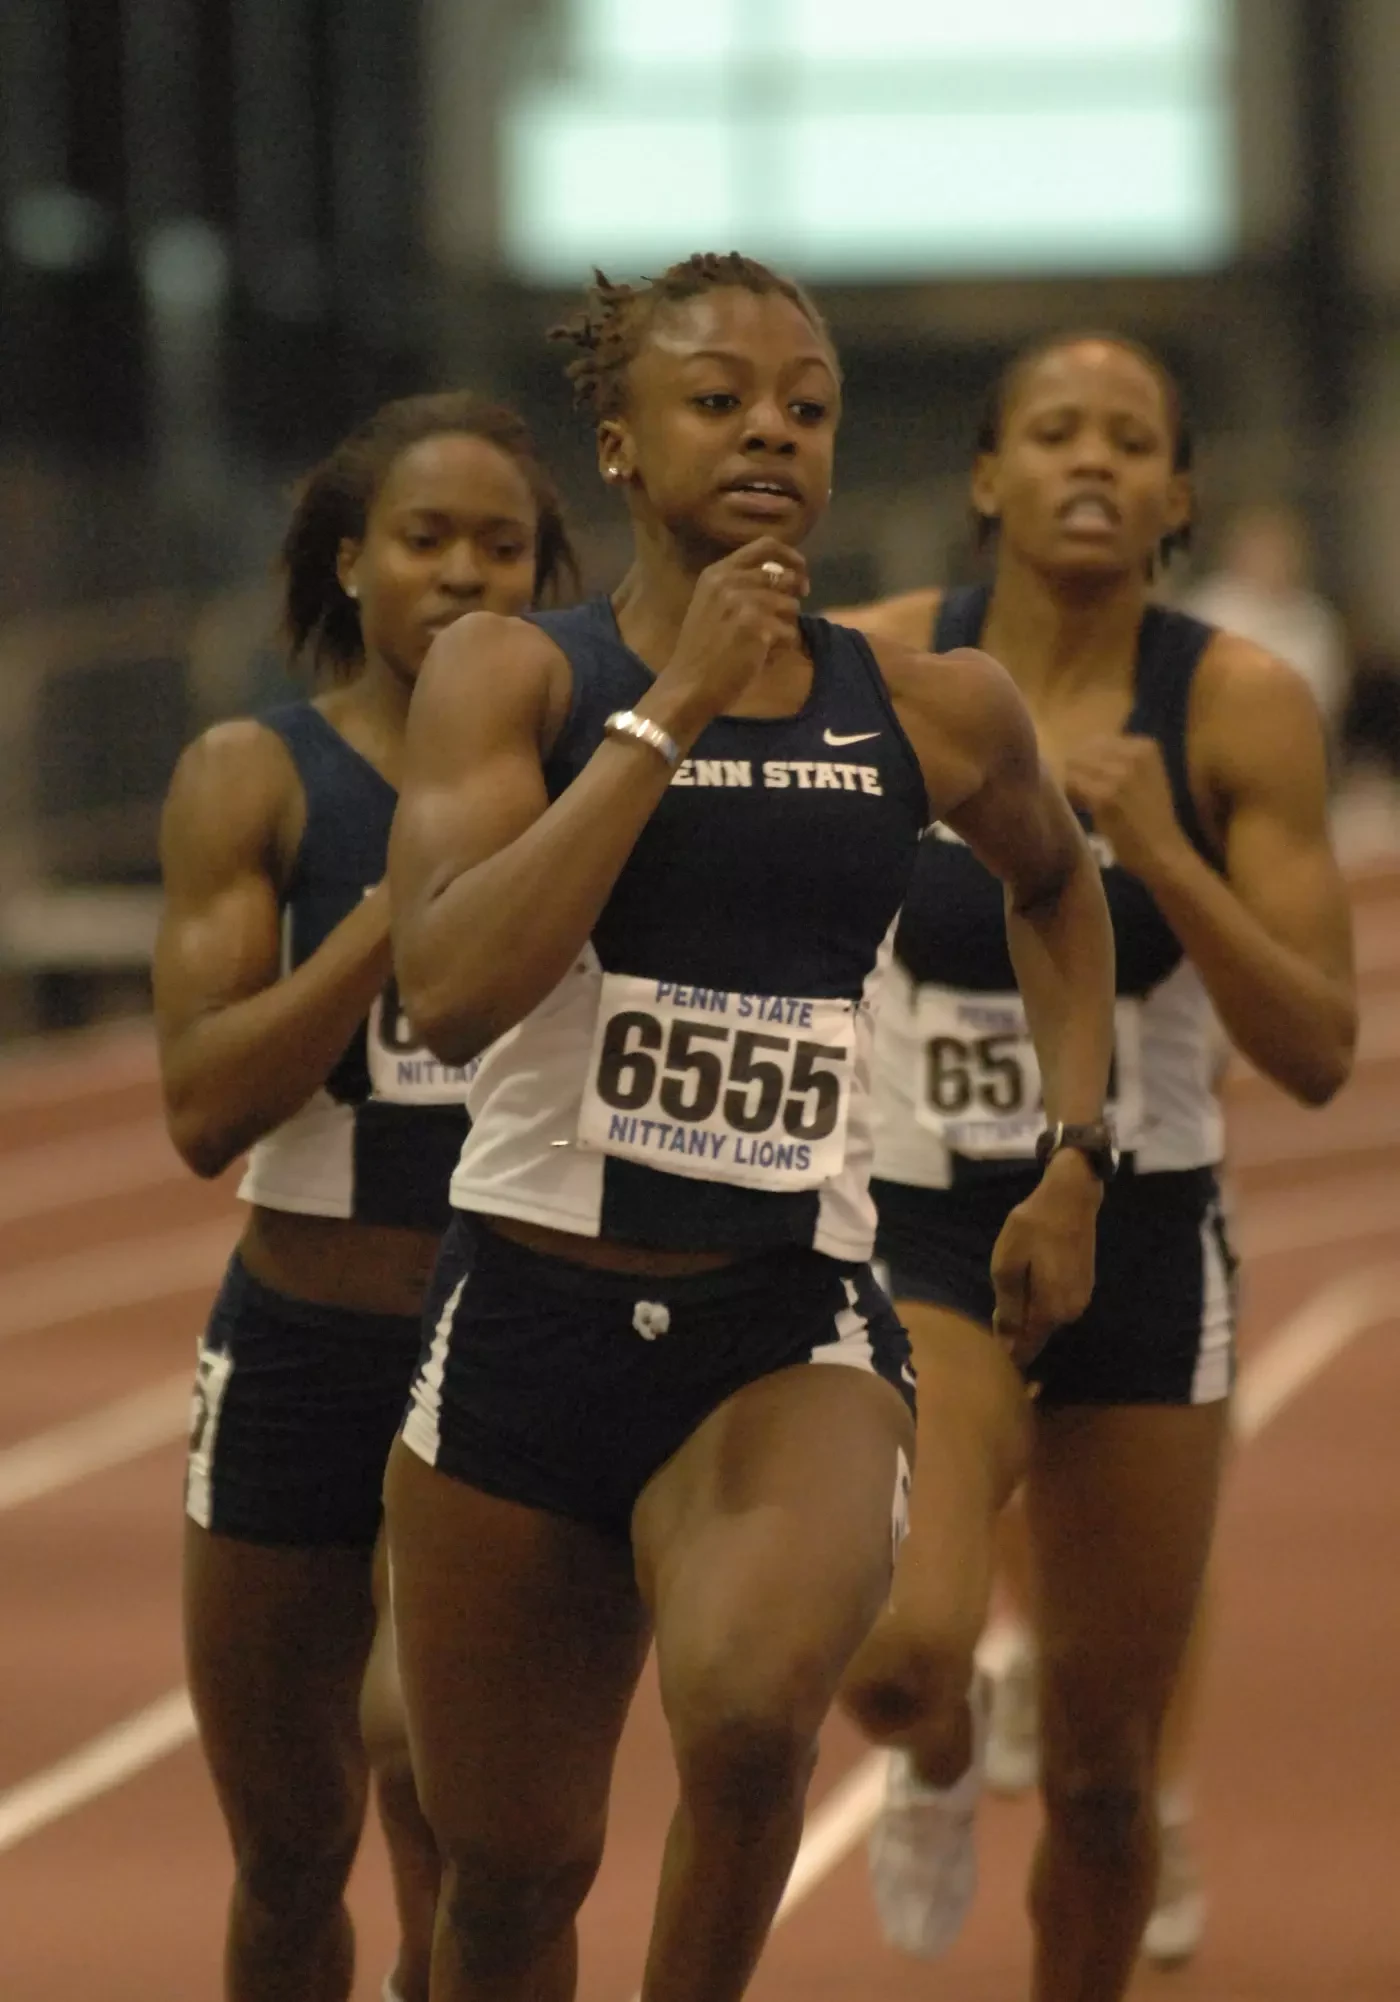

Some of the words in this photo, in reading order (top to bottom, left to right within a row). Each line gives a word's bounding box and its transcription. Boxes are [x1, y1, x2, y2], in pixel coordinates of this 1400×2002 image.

[670, 759, 752, 787] ENN
[762, 761, 884, 797] STATE
[655, 978, 728, 1014] PENN
[737, 992, 814, 1029] STATE
[596, 1010, 848, 1142] 6555
[926, 1033, 1040, 1117] 65
[607, 1113, 727, 1160] NITTANY
[733, 1136, 812, 1172] LIONS
